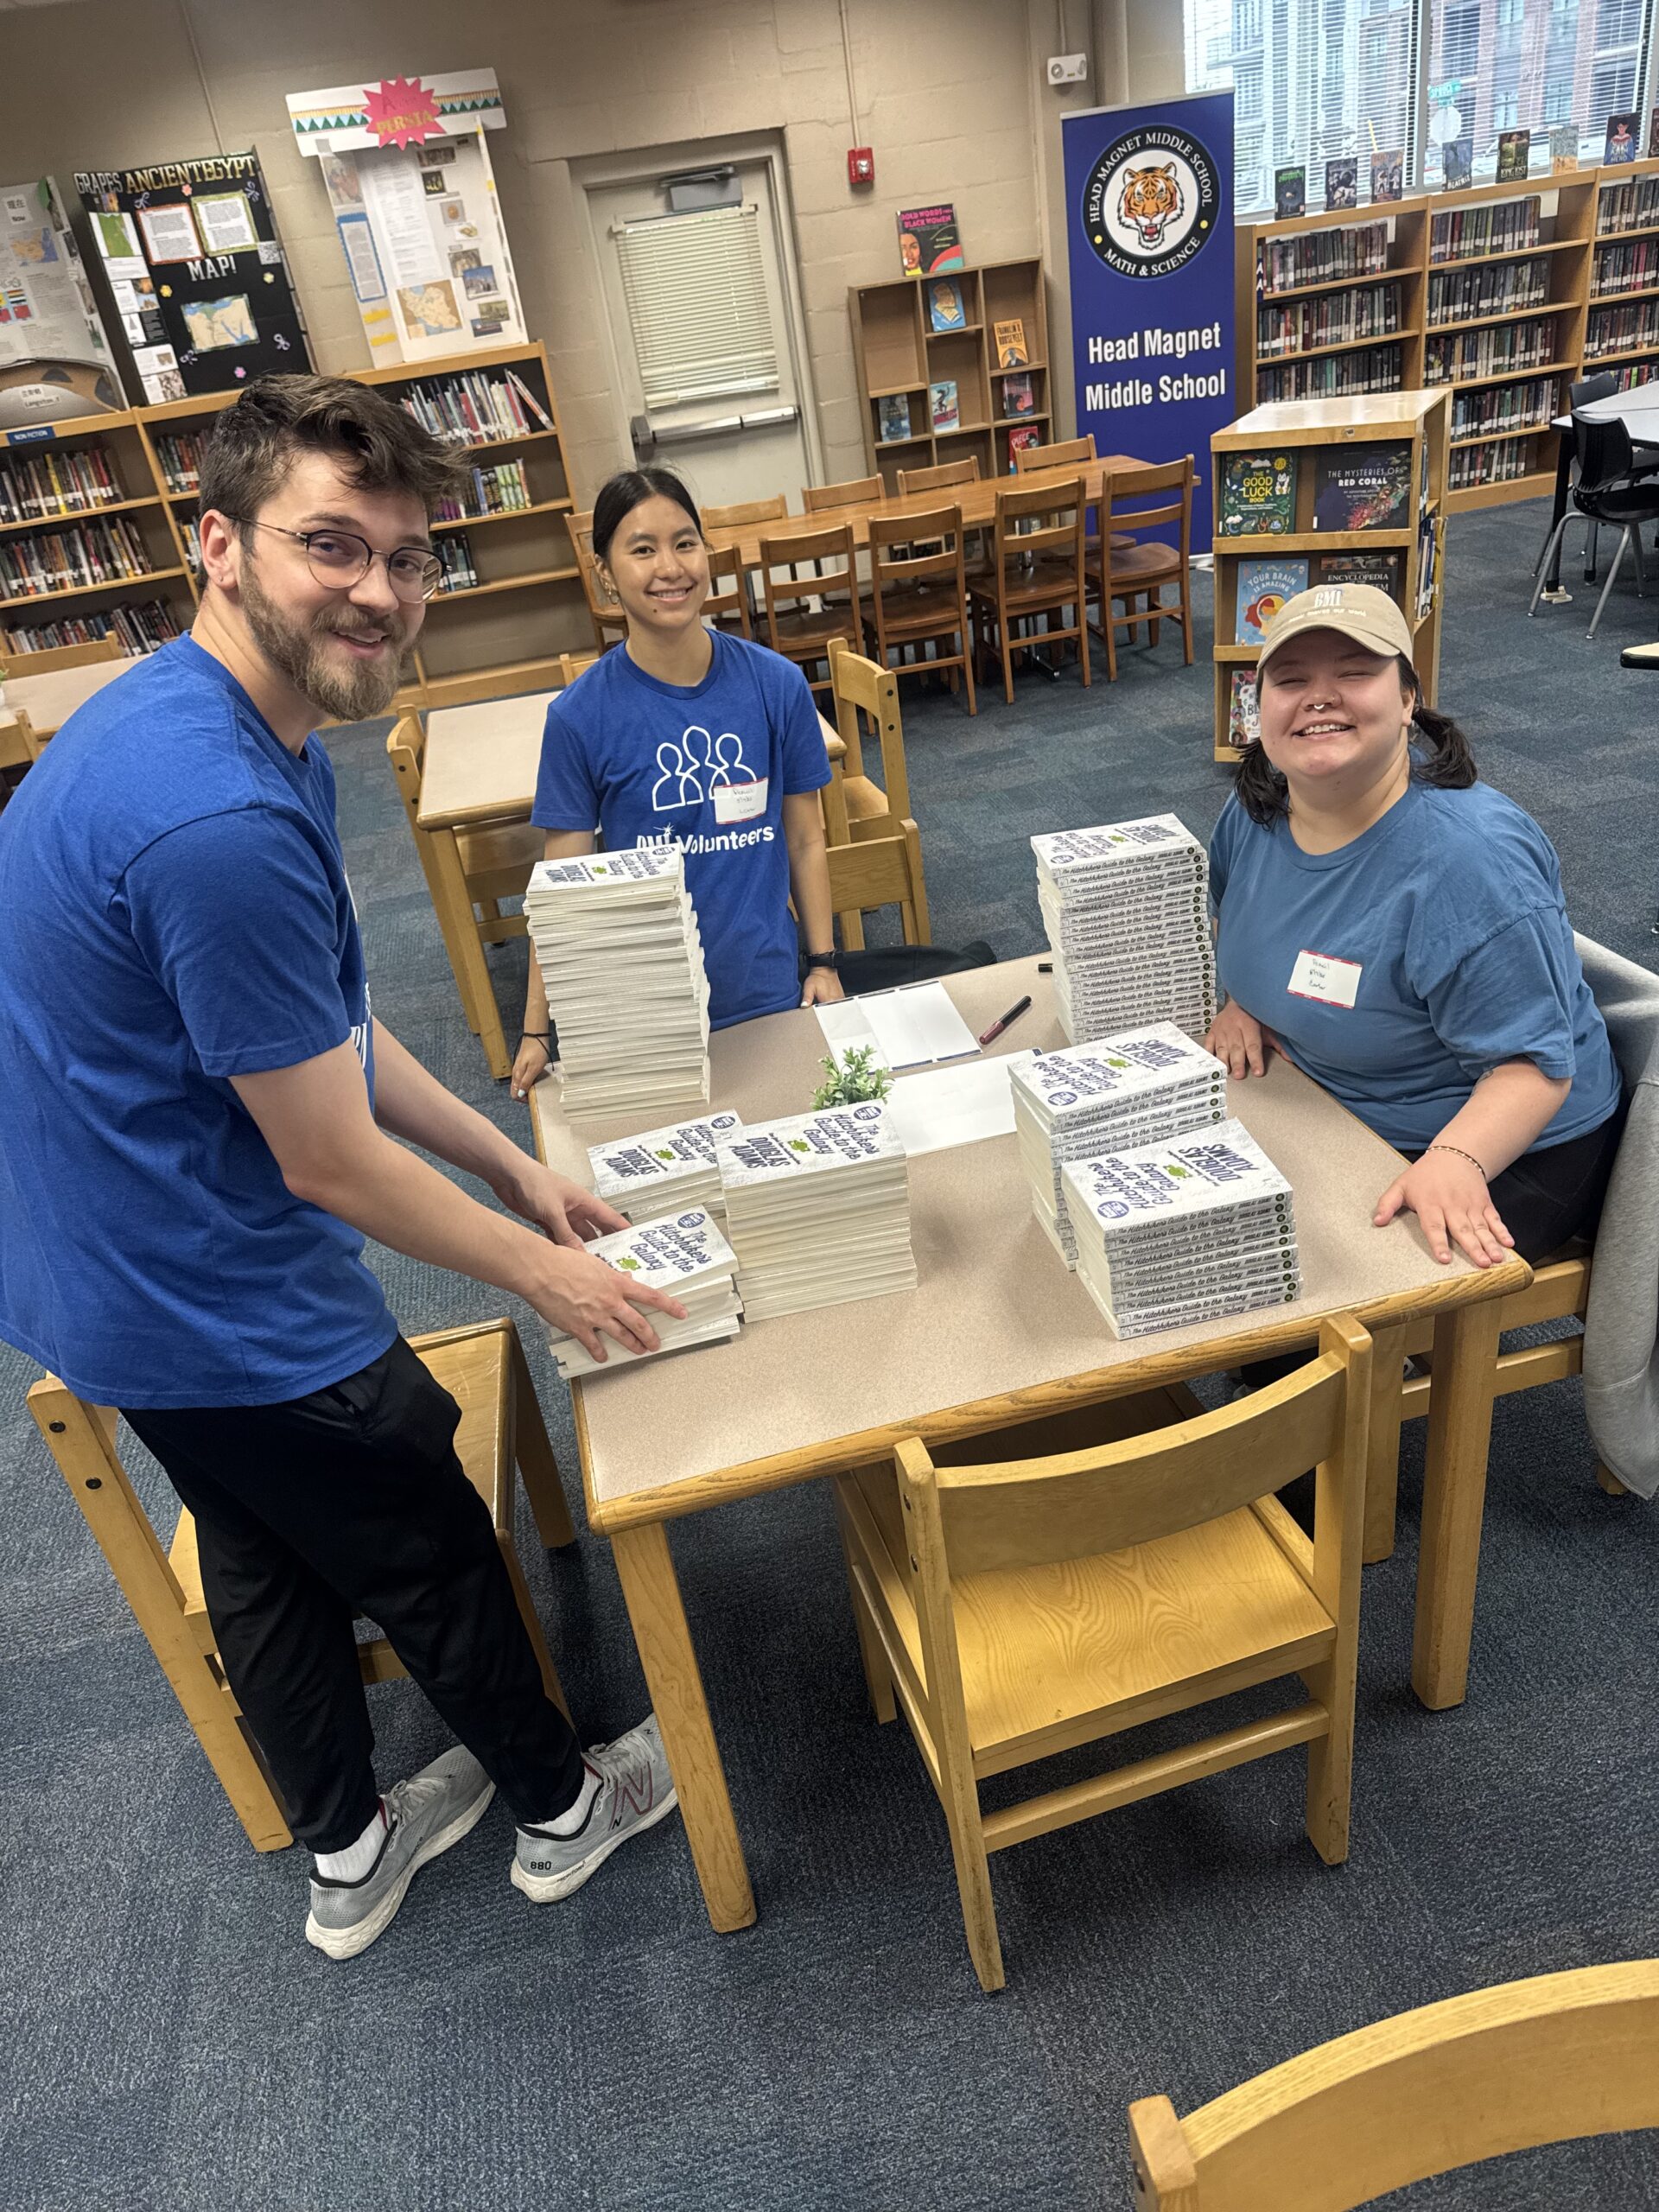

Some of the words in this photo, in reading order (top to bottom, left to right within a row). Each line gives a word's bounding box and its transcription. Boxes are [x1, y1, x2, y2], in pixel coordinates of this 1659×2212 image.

[1145, 131, 1193, 156] MIDDLE
[1096, 135, 1142, 181] MAGNET
[73, 173, 124, 194] GRAPES
[126, 162, 202, 194] ANCIENT
[201, 155, 256, 181] EGYPT
[1190, 153, 1213, 207] SCHOOL
[1090, 182, 1103, 223] HEAD
[1103, 248, 1136, 275] MATH
[1139, 264, 1149, 276] &
[1151, 236, 1201, 276] SCIENCE
[187, 256, 238, 282] MAP!
[1088, 331, 1139, 364] Head
[1144, 321, 1221, 359] Magnet
[1085, 378, 1154, 411] Middle
[1159, 368, 1225, 403] School
[1243, 476, 1273, 487] GOOD
[1327, 470, 1342, 479] THE
[1344, 467, 1384, 478] MYSTERIES
[1338, 479, 1356, 487] RED
[1357, 476, 1388, 486] CORAL
[1243, 486, 1273, 498] LUCK
[1247, 572, 1271, 587] YOUR
[1272, 571, 1297, 586] BRAIN
[1253, 585, 1261, 594] IS
[1261, 582, 1292, 592] AMAZING
[1327, 573, 1389, 582] ENCYCLOPEDIA
[675, 826, 775, 855] Volunteers
[1116, 1042, 1180, 1067] DOUGLAS
[1137, 1039, 1195, 1058] ADAMS
[1048, 1055, 1073, 1068] the
[1066, 1065, 1084, 1074] to
[1077, 1057, 1123, 1079] Galaxy
[1040, 1077, 1061, 1090] The
[1079, 1073, 1119, 1091] Guide
[813, 1117, 842, 1140] Guide
[863, 1123, 881, 1136] The
[1111, 1129, 1130, 1144] Guide
[1139, 1125, 1150, 1136] the
[1151, 1120, 1173, 1136] Galaxy
[668, 1139, 699, 1161] Galaxy
[677, 1128, 701, 1148] Guide
[695, 1145, 709, 1154] to
[702, 1152, 718, 1165] the
[746, 1136, 791, 1167] DOUGLAS
[803, 1128, 836, 1155] Galaxy
[833, 1137, 849, 1147] to
[840, 1145, 862, 1160] the
[601, 1157, 641, 1179] ADAMS
[617, 1148, 659, 1175] DOUGLAS
[728, 1145, 769, 1169] ADAMS
[1105, 1156, 1130, 1173] the
[1177, 1147, 1244, 1183] DOUGLAS
[1202, 1142, 1261, 1172] ADAMS
[1122, 1170, 1141, 1181] to
[1135, 1162, 1181, 1192] Galaxy
[1093, 1183, 1115, 1197] The
[1135, 1181, 1174, 1206] Guide
[1167, 1224, 1187, 1236] Guide
[1189, 1223, 1196, 1231] to
[1197, 1219, 1209, 1230] the
[1211, 1212, 1235, 1228] Galaxy
[638, 1230, 671, 1252] Guide
[691, 1230, 708, 1243] The
[1173, 1245, 1192, 1257] Guide
[1194, 1243, 1202, 1252] to
[1203, 1241, 1214, 1250] the
[1216, 1235, 1240, 1249] Galaxy
[629, 1243, 668, 1271] Galaxy
[663, 1249, 681, 1260] to
[671, 1257, 696, 1273] the
[1181, 1300, 1201, 1312] Guide
[1203, 1299, 1210, 1307] to
[1211, 1296, 1222, 1306] the
[1224, 1291, 1248, 1305] Galaxy
[530, 1860, 552, 1871] 880
